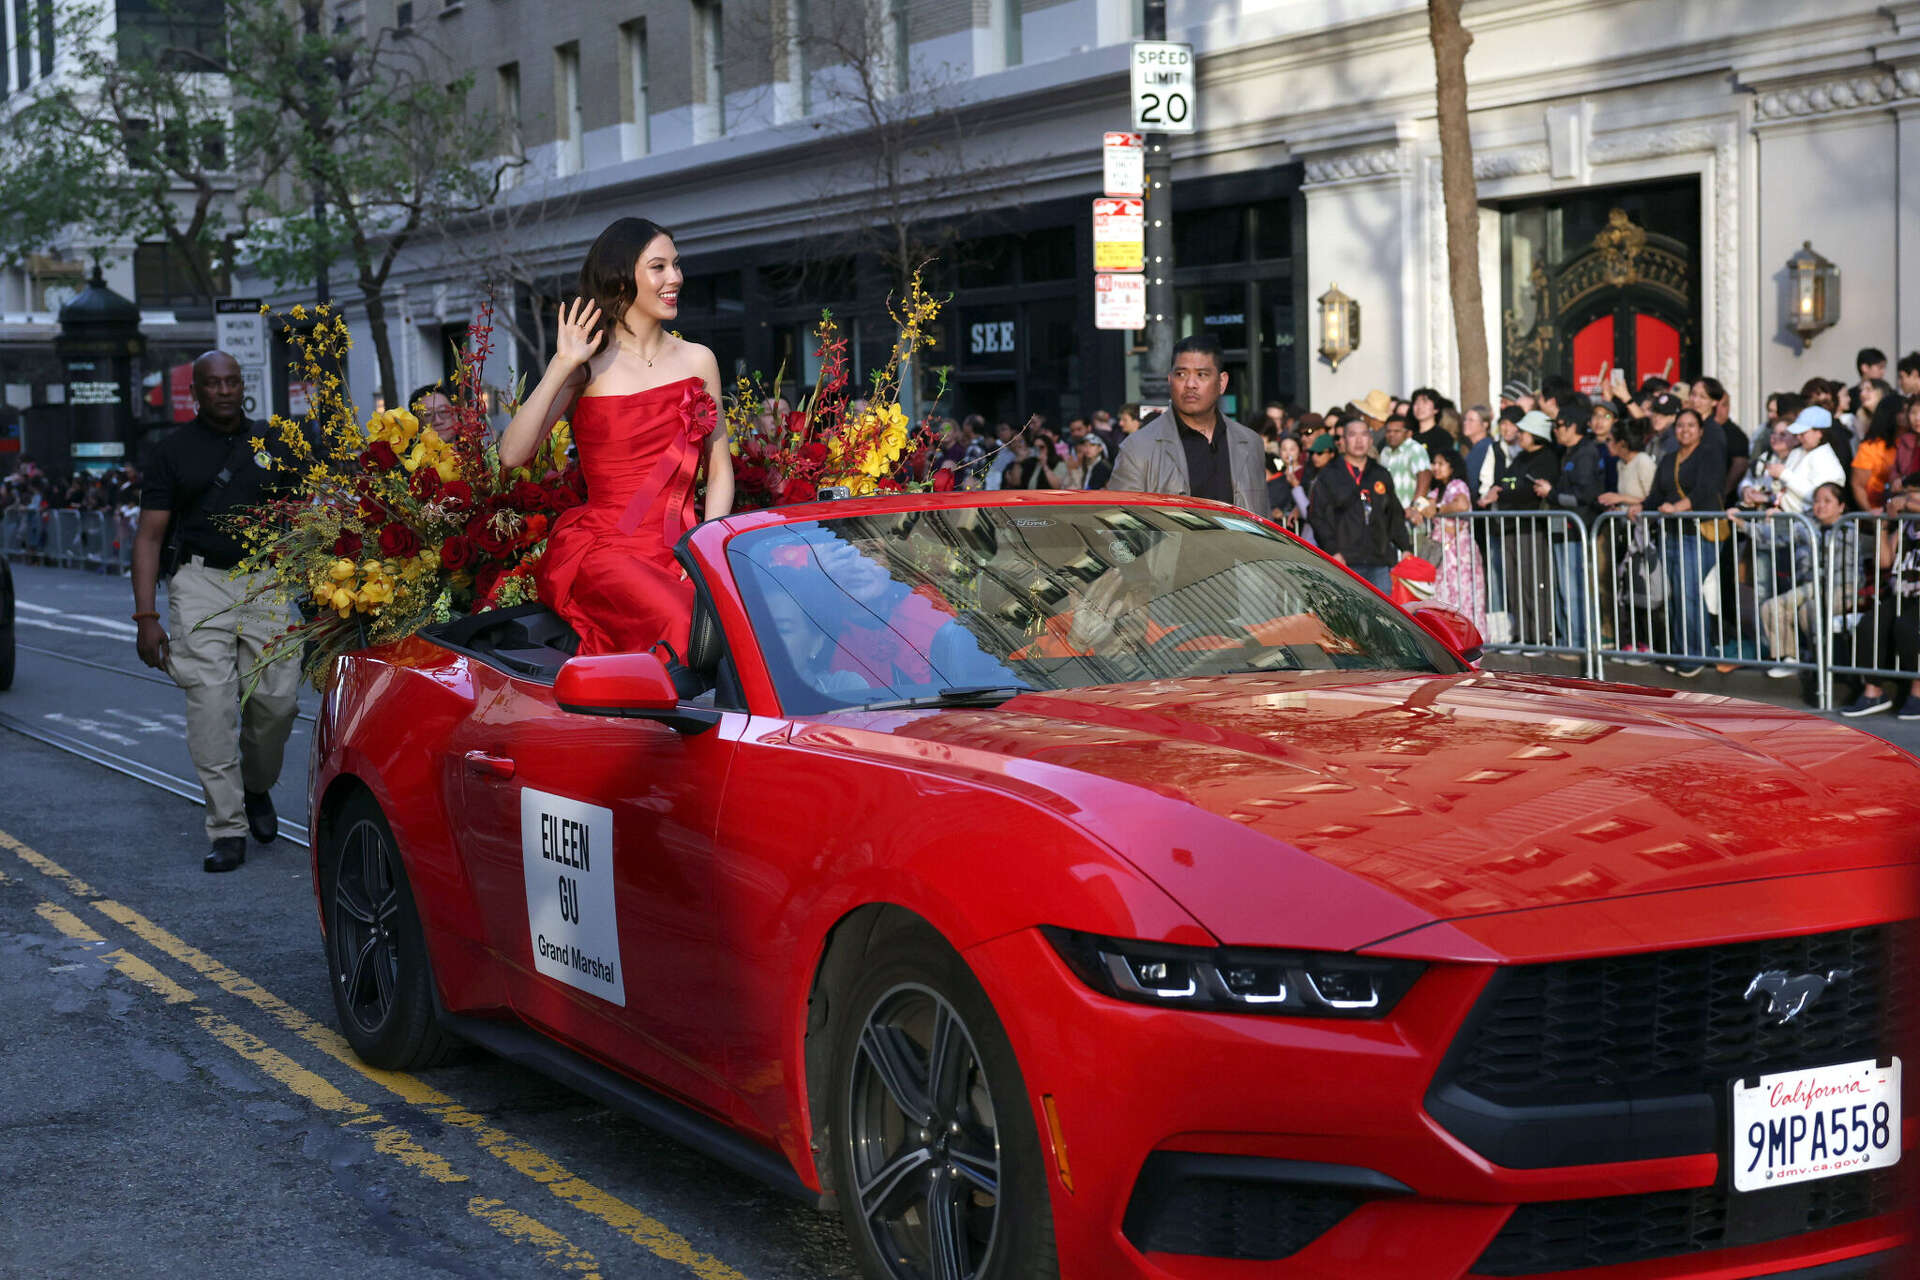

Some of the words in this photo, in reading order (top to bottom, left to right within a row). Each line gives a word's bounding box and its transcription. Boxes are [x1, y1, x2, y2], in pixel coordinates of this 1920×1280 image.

[1138, 51, 1189, 65] SPEED
[1144, 71, 1183, 85] LIMIT
[1140, 93, 1188, 123] 20
[226, 336, 255, 346] ONLY
[971, 321, 1015, 353] SEE
[541, 813, 591, 872] EILEEN
[558, 875, 580, 925] GU
[538, 934, 569, 966] Grand
[572, 946, 615, 985] Marshal
[1770, 1078, 1870, 1110] California
[1747, 1101, 1890, 1172] 9MPA558
[1776, 1157, 1860, 1179] dmv.ca.gov
